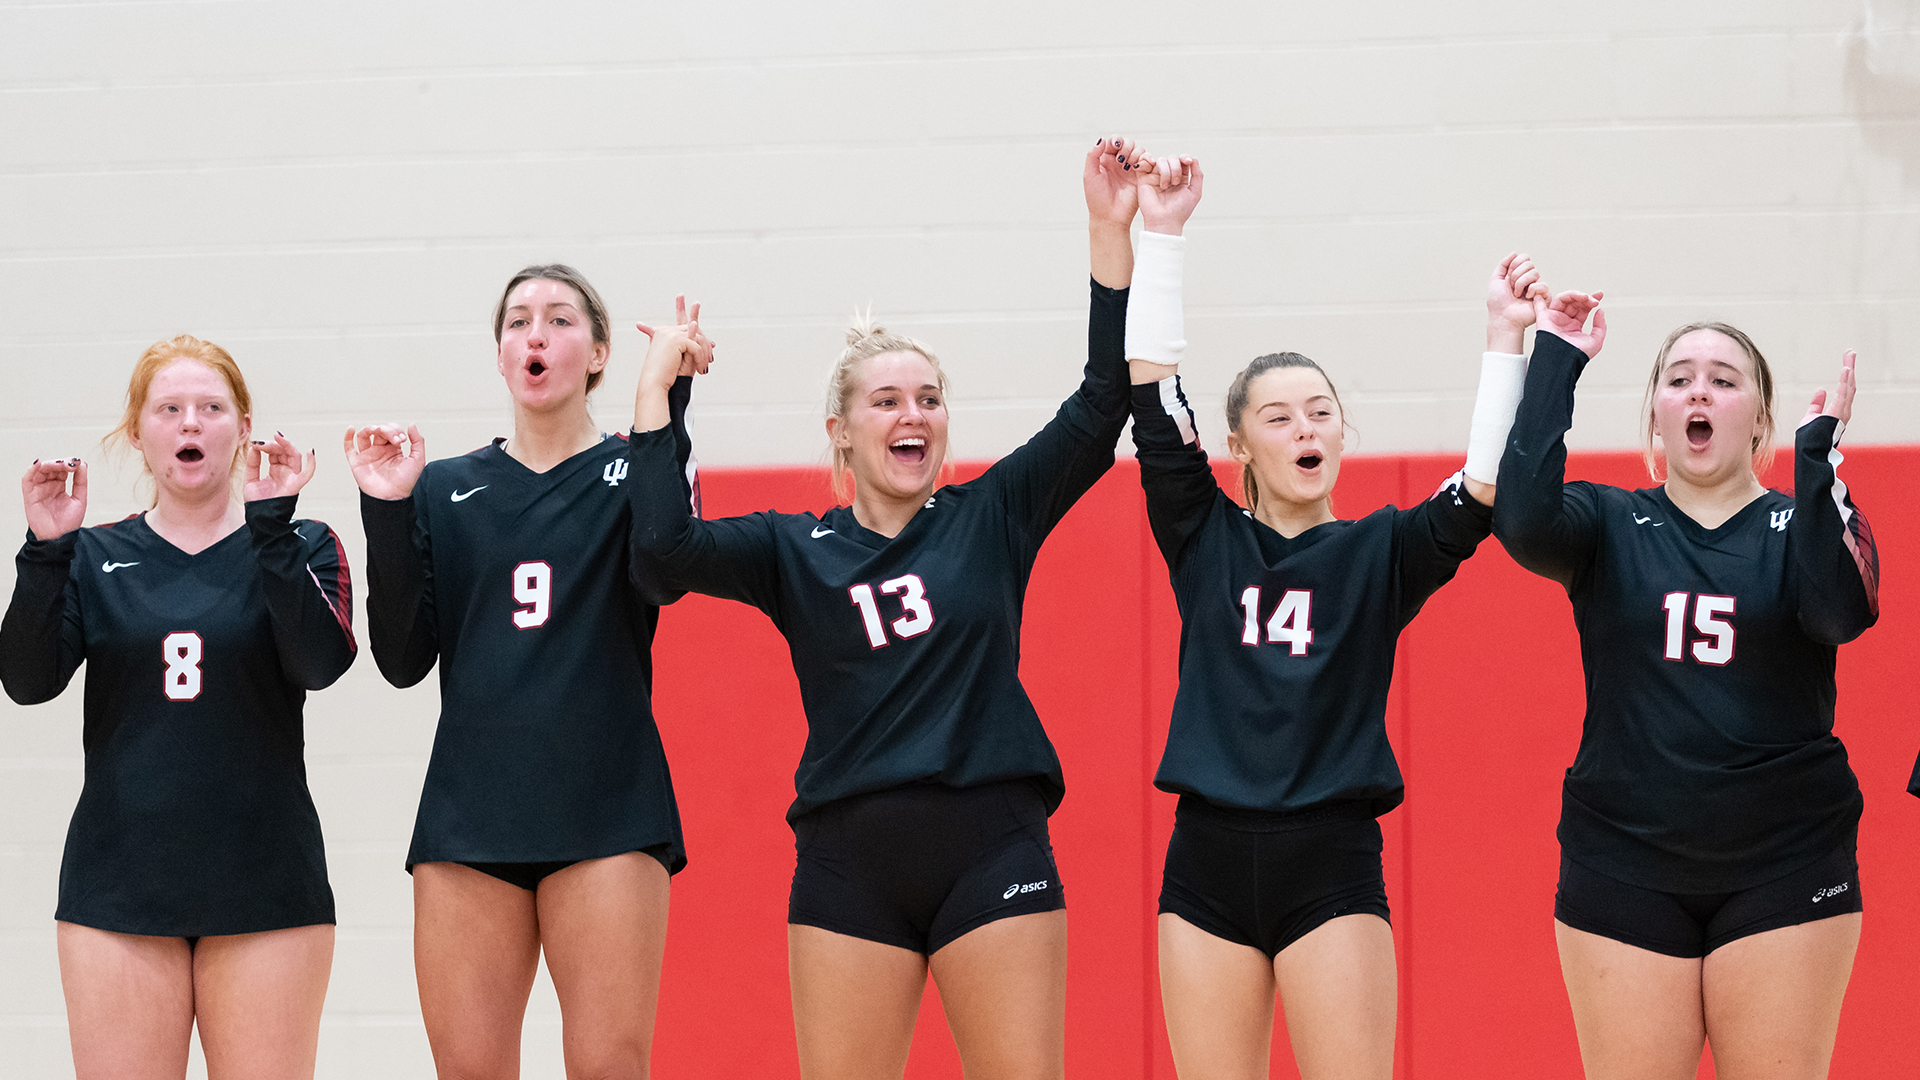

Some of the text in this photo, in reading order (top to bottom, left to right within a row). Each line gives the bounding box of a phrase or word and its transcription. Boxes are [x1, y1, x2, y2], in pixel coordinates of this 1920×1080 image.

[511, 560, 552, 631] 9
[848, 573, 935, 649] 13
[1240, 585, 1313, 656] 14
[1662, 591, 1737, 666] 15
[162, 630, 203, 702] 8
[1020, 879, 1048, 894] asics
